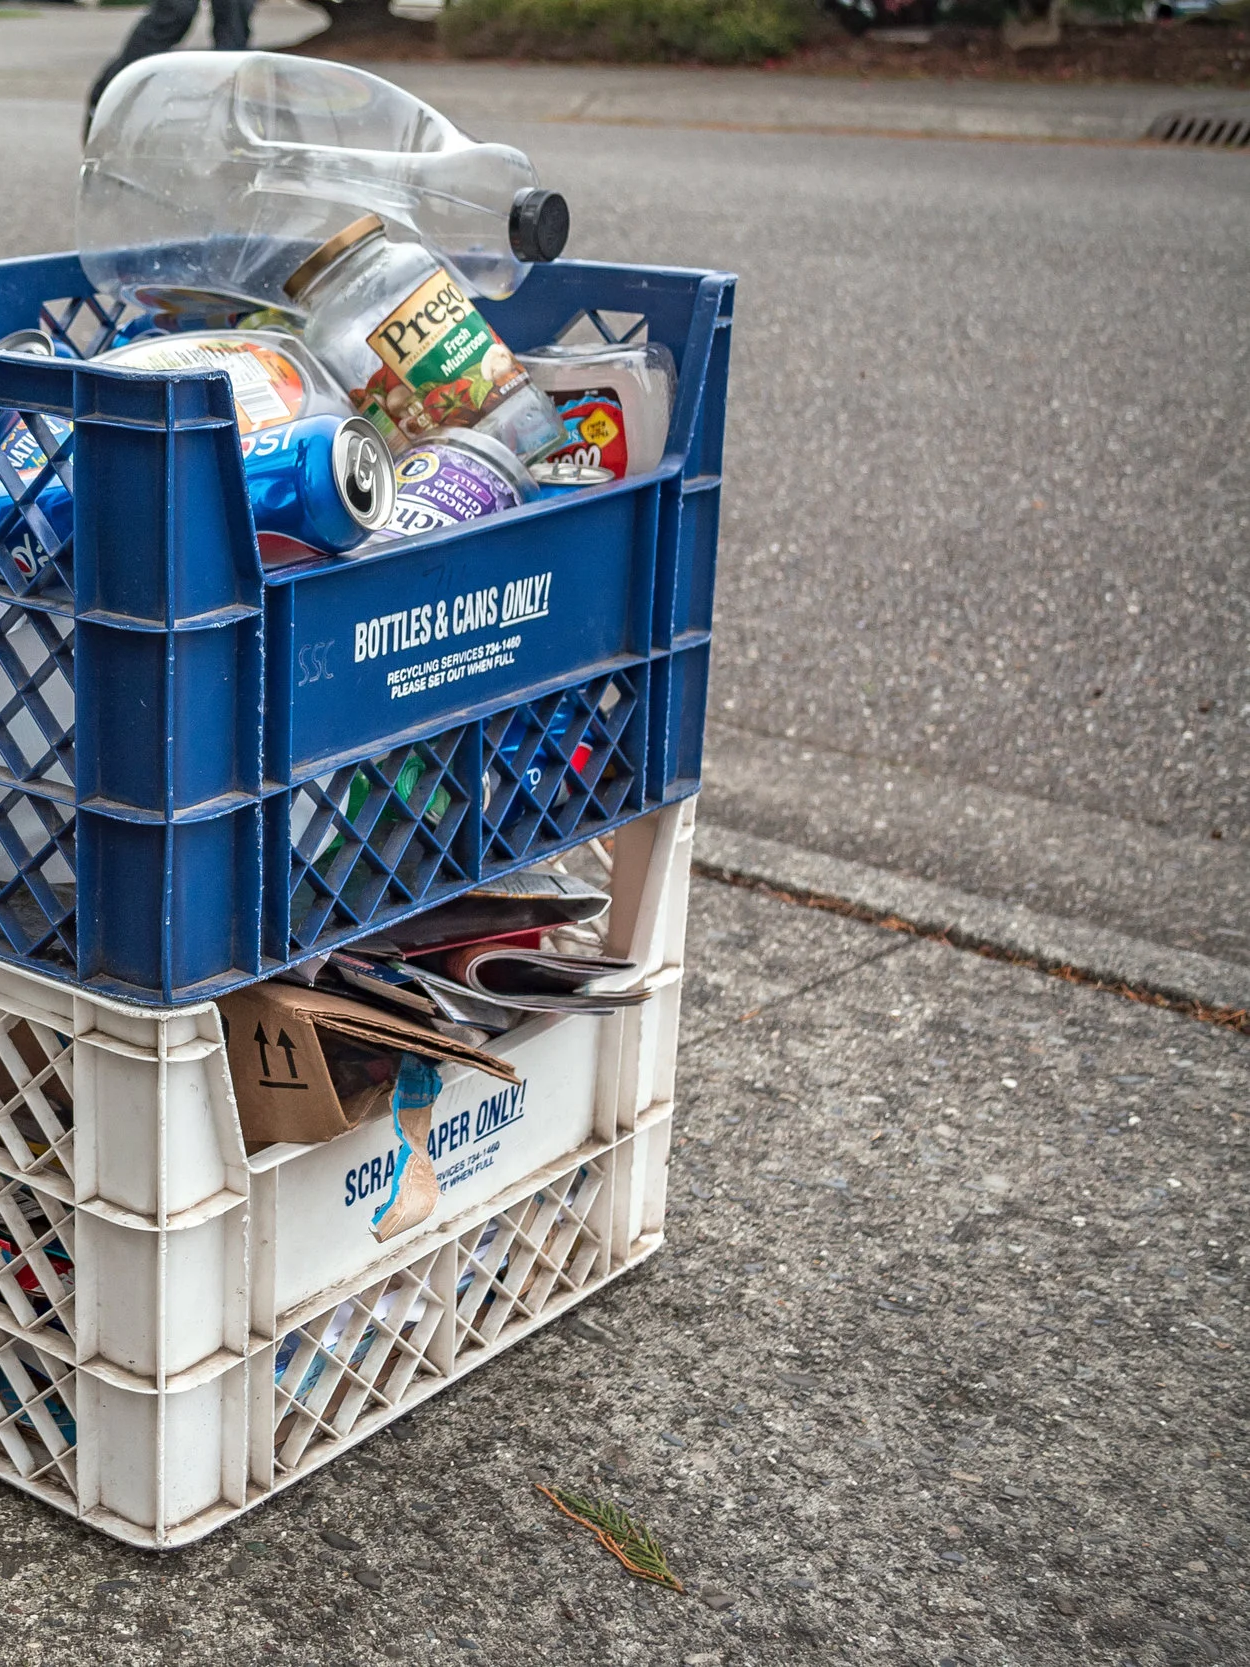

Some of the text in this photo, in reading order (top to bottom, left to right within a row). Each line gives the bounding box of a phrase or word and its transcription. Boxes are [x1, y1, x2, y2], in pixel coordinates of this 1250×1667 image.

[379, 283, 466, 365] Prego
[443, 327, 472, 355] Fresh
[440, 330, 488, 377] Mushroom
[416, 484, 475, 521] oncord
[434, 479, 482, 515] Grape
[453, 474, 482, 494] JELLY
[354, 604, 432, 663] BOTTLES
[434, 600, 449, 640] &
[452, 586, 499, 635] CANS
[501, 571, 552, 624] ONLY!
[387, 659, 439, 686] RECYCLING
[440, 646, 485, 670] SERVICES
[391, 651, 515, 700] PLEASE SET OUT WHEN FULL
[344, 1079, 528, 1207] SCRA APER ONLY!
[436, 1160, 465, 1181] RVICES
[450, 1166, 474, 1187] WHEN
[475, 1155, 495, 1173] FULL
